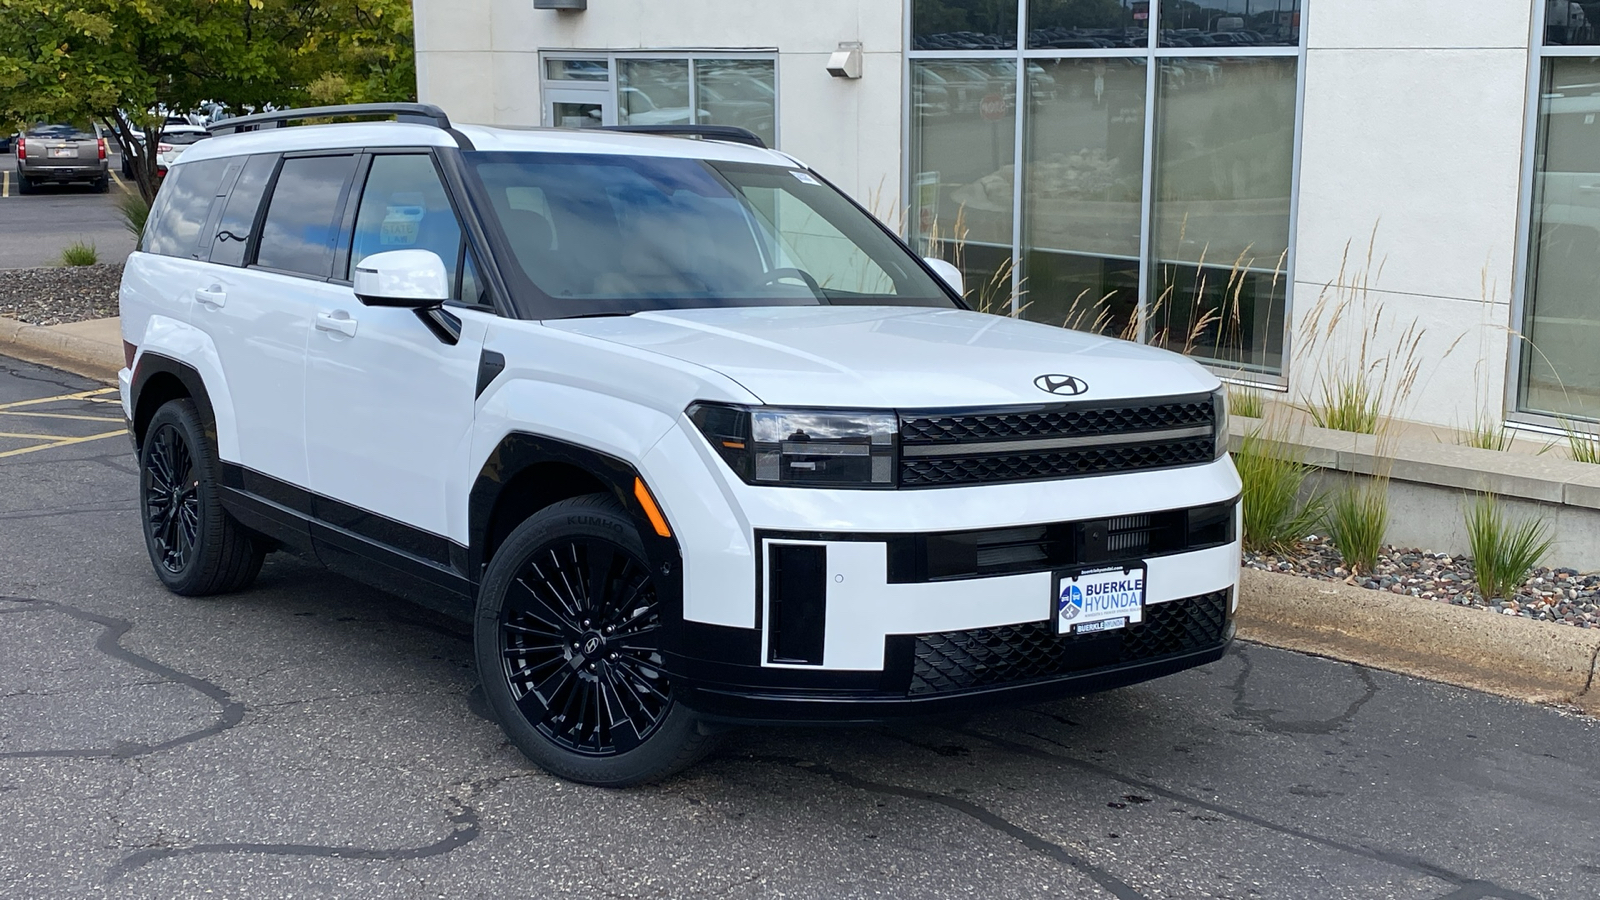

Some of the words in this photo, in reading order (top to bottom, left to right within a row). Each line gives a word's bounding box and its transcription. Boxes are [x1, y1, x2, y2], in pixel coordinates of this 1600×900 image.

[383, 225, 413, 234] STATE
[567, 515, 624, 533] KUMHO
[1086, 579, 1142, 596] BUERKLE
[1085, 591, 1142, 613] HYUNDAI
[1077, 621, 1104, 633] BUERKLE
